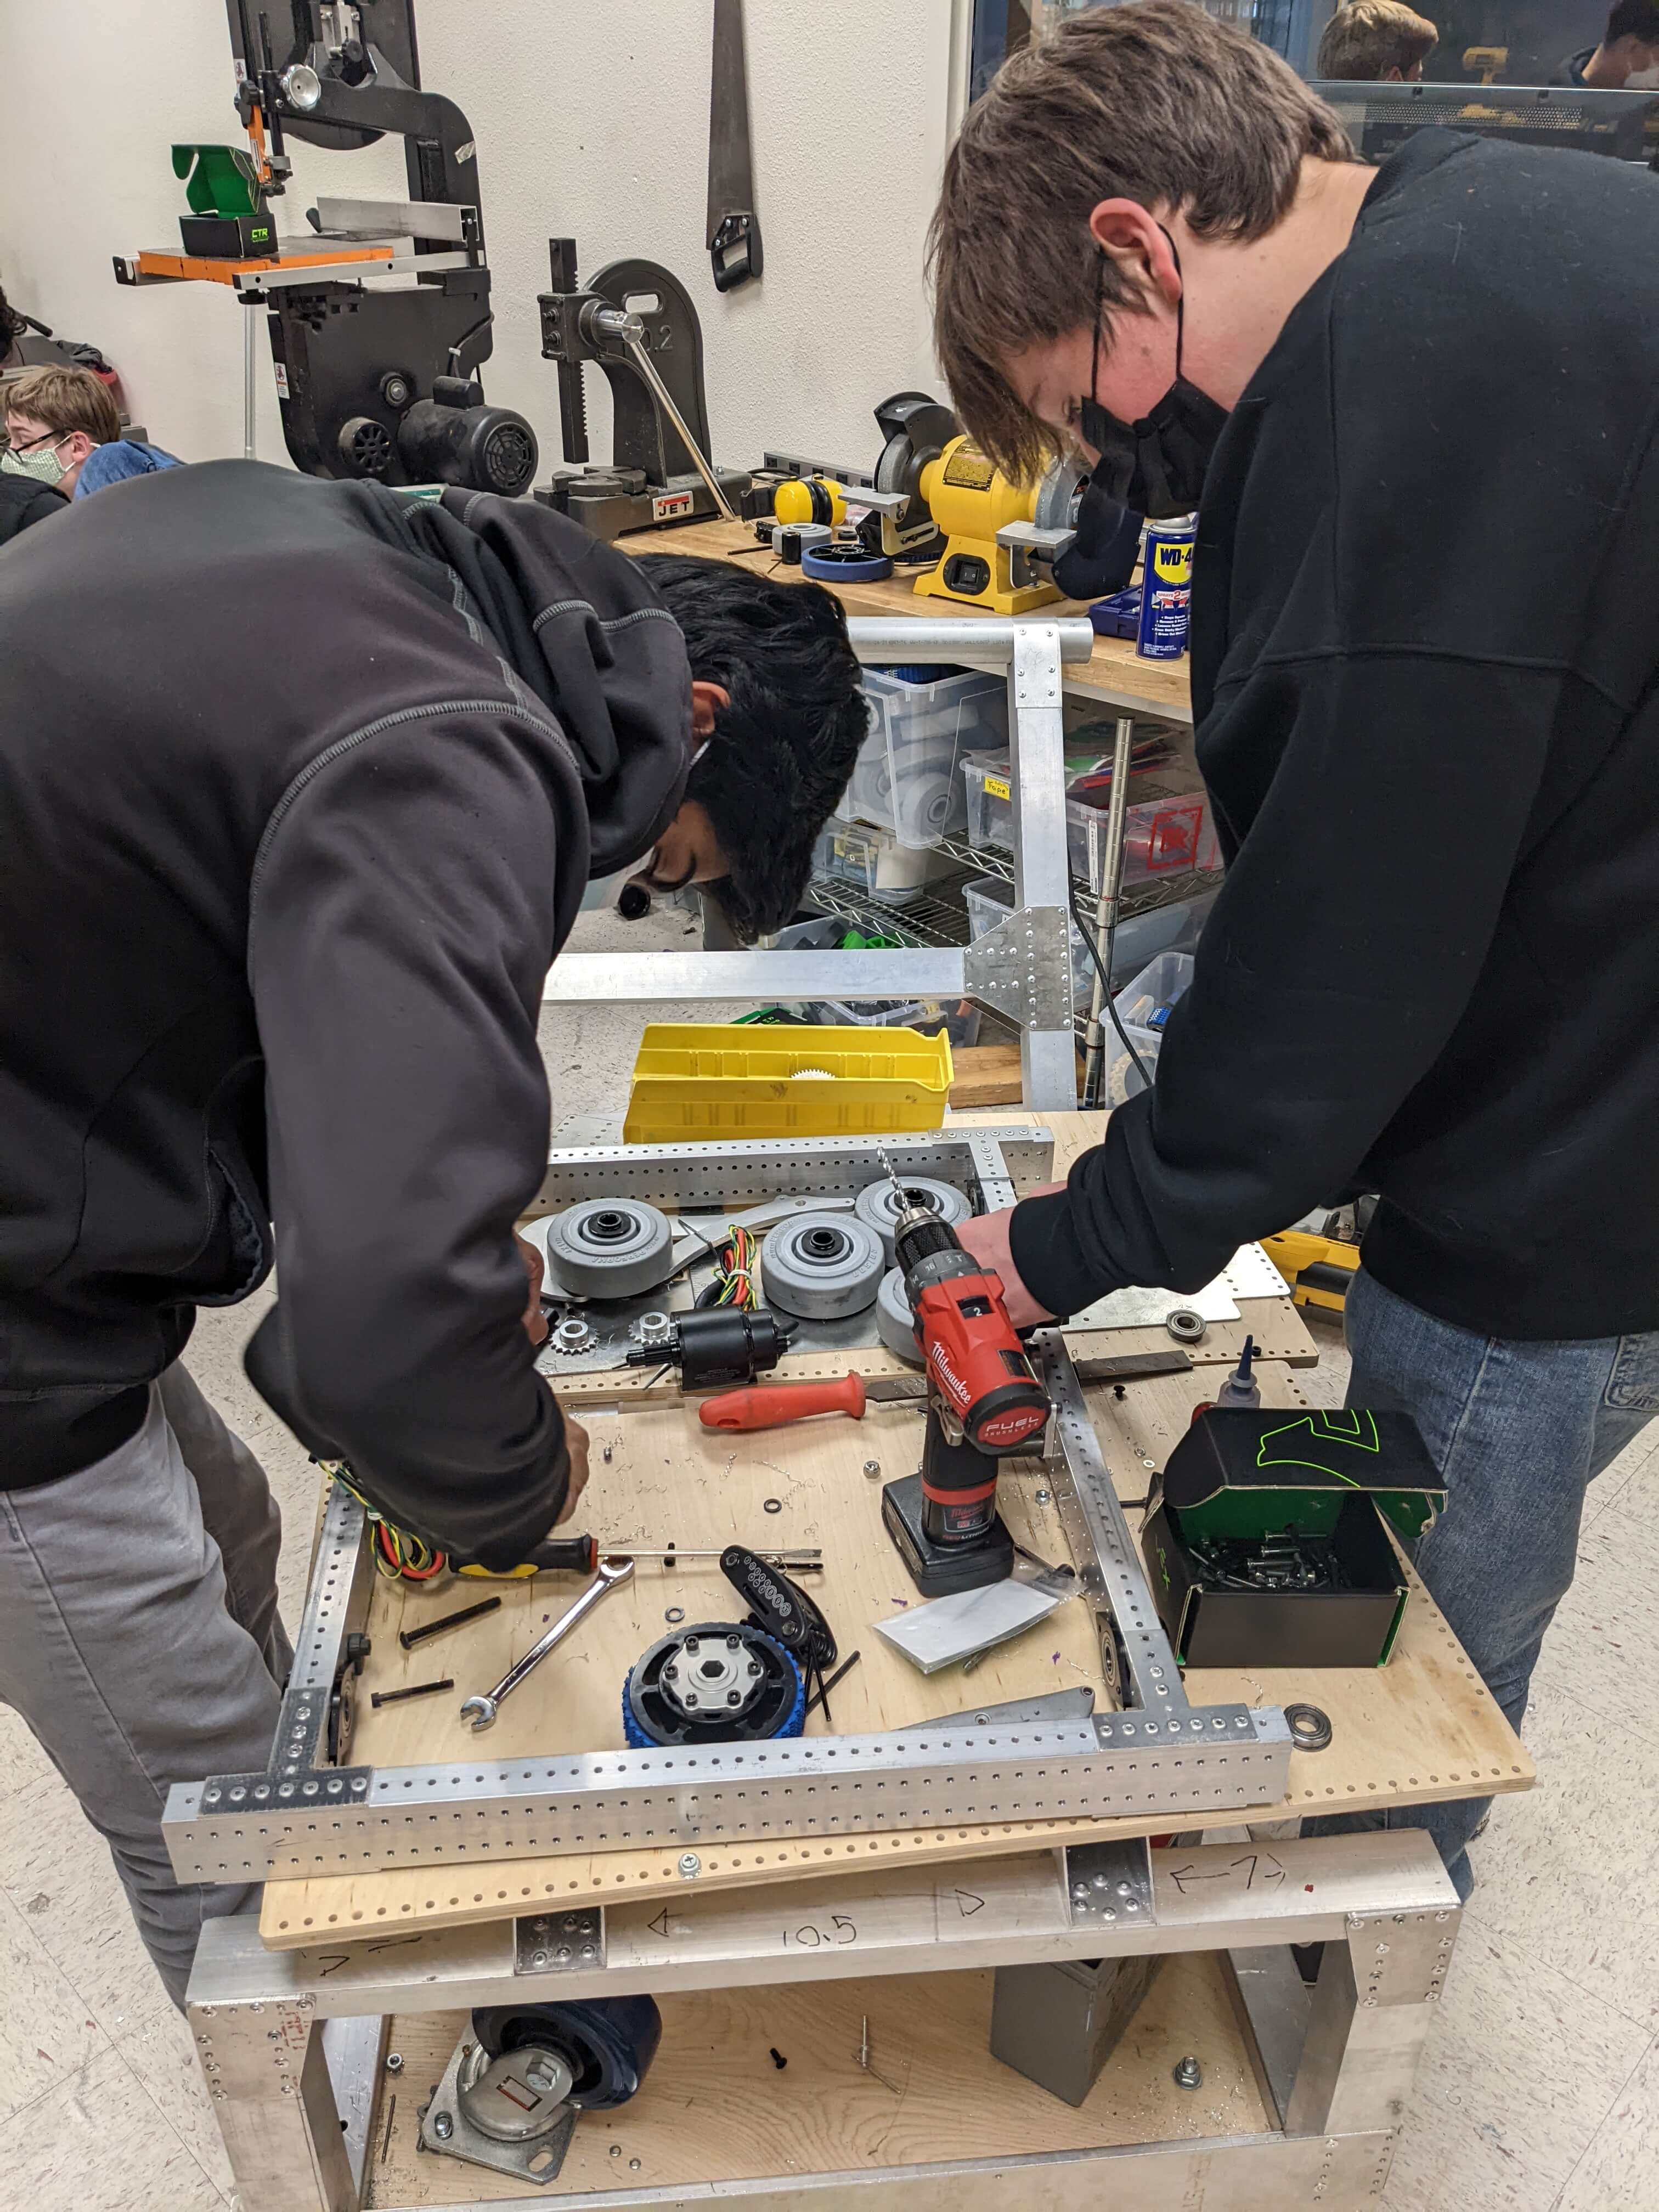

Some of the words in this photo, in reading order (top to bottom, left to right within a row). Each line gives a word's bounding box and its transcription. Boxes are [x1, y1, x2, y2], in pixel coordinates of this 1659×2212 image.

[252, 228, 268, 238] CTR
[659, 500, 690, 516] JET
[1160, 547, 1193, 566] WD-4
[1173, 591, 1181, 600] 2
[988, 781, 1006, 794] Tape
[973, 1307, 983, 1317] 2
[932, 1341, 972, 1404] Milwaukee
[984, 1422, 1038, 1437] BRUSHLESS
[986, 1417, 1039, 1432] FUEL
[783, 1915, 857, 1947] 10.5
